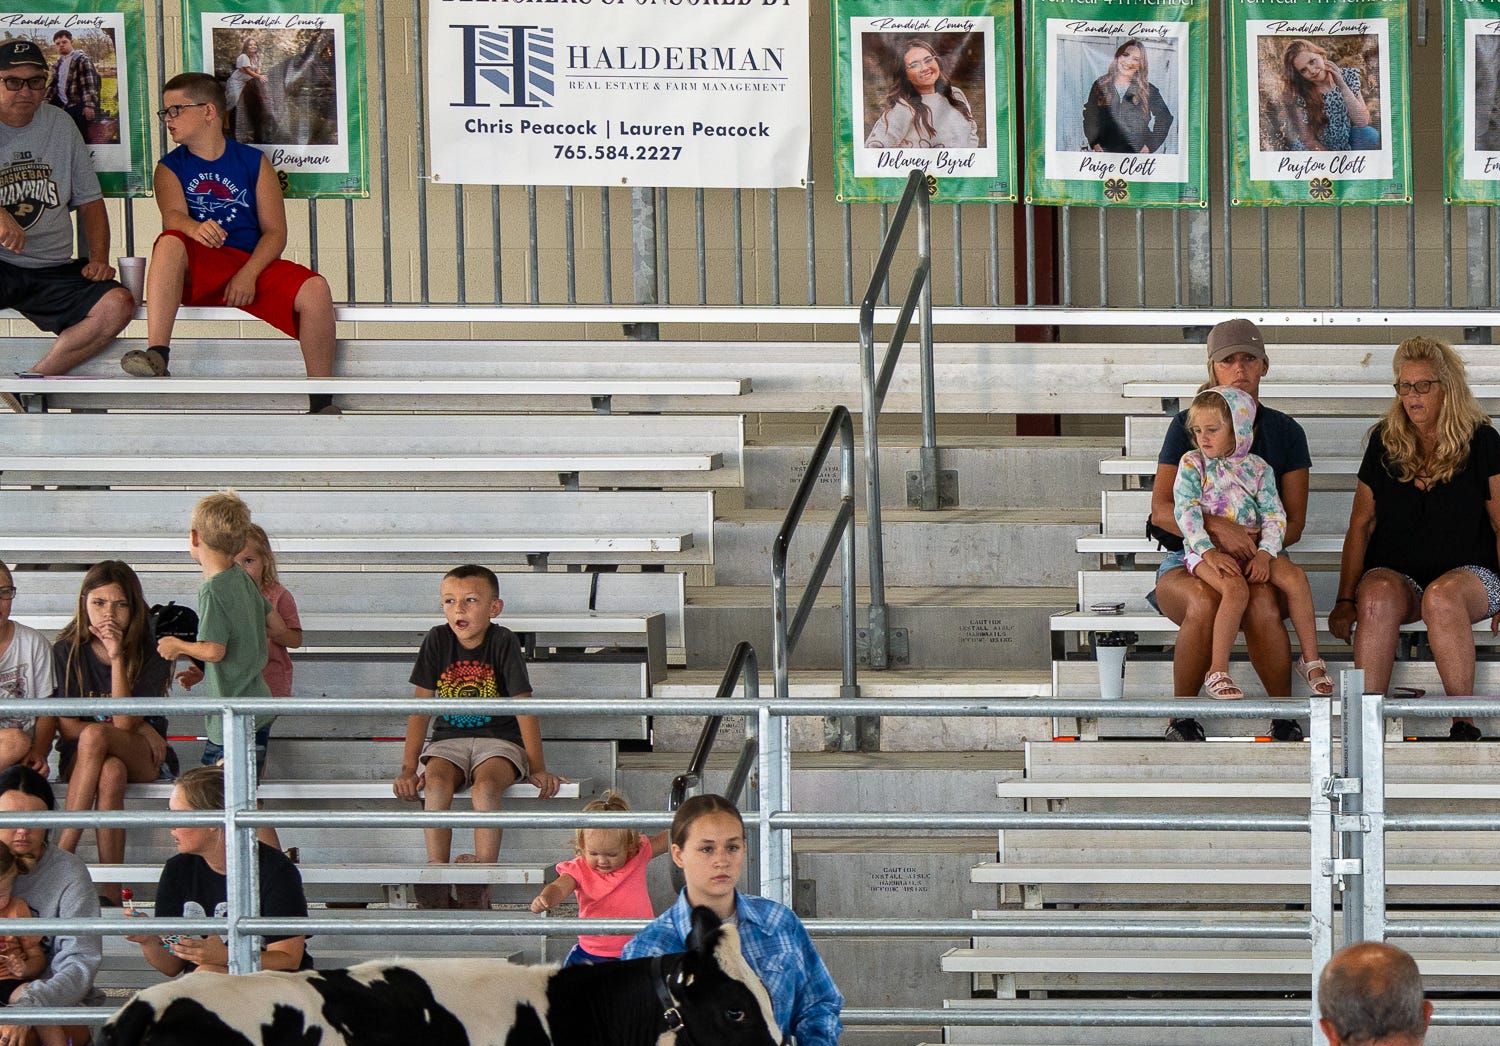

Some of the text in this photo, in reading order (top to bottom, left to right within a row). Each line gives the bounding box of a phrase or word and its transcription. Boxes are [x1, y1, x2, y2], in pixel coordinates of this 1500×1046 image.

[0, 13, 104, 28] Randolph County
[221, 13, 327, 29] Randolph County
[870, 17, 976, 32] Randolph County
[1065, 21, 1171, 37] Randolph County
[1266, 20, 1371, 35] Randolph County
[566, 45, 785, 72] HALDERMAN
[568, 80, 786, 93] REAL ESTATE & FARM MANAGEMENT
[464, 118, 514, 136] Chris
[519, 120, 598, 136] Peacock
[619, 121, 685, 137] Lauren
[691, 121, 770, 138] Peacock
[271, 149, 331, 167] Bousman
[553, 144, 683, 162] 765.584.2227
[877, 150, 976, 175] Delaney Byrd
[1079, 156, 1157, 179] Paige Clott
[1278, 155, 1367, 180] Payton Clott
[187, 178, 200, 193] RED
[221, 177, 239, 195] BLUE
